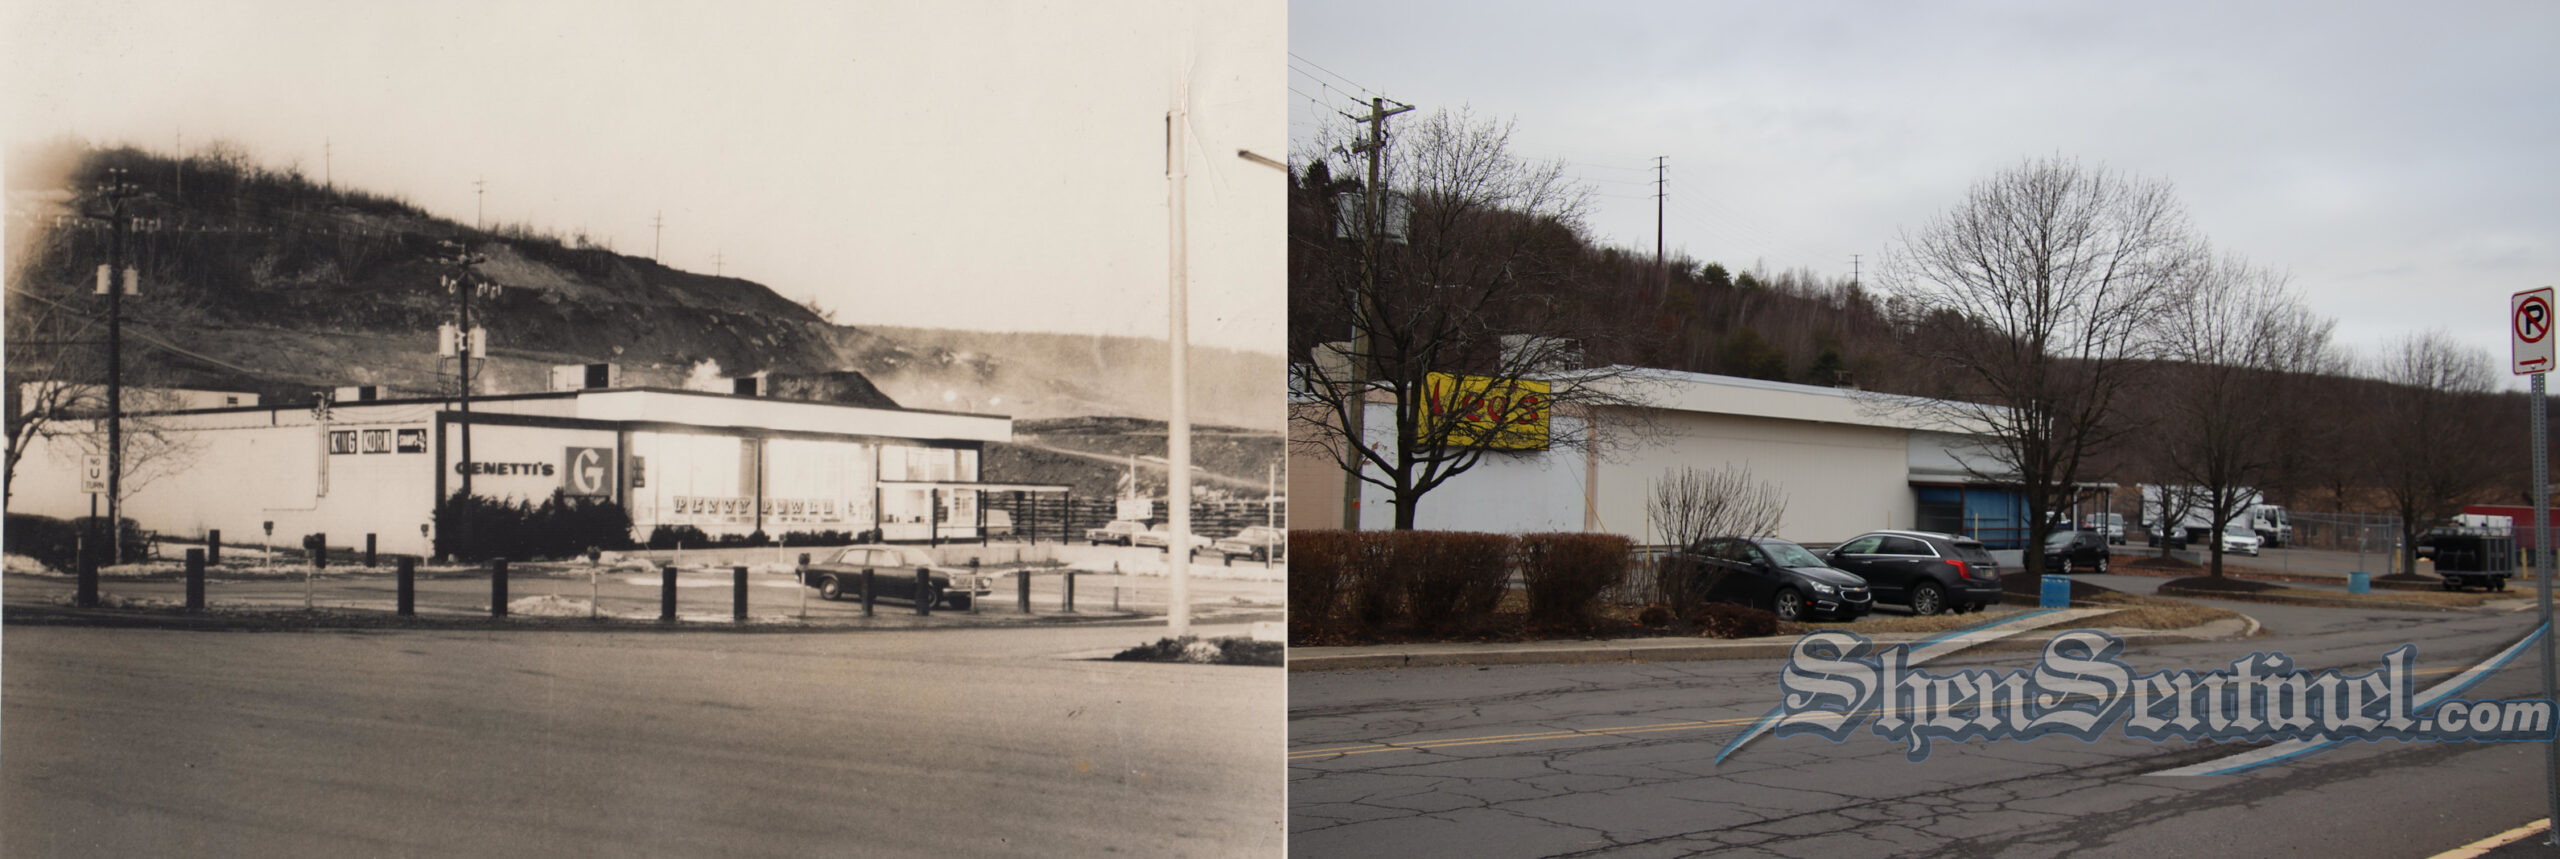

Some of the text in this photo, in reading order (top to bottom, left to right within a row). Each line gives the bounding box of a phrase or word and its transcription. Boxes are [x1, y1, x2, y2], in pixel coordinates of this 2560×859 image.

[330, 432, 356, 453] KING
[363, 430, 391, 452] KORN
[90, 468, 100, 479] U
[455, 461, 555, 477] GENETTI'S
[573, 448, 605, 495] G
[86, 481, 104, 489] TURN
